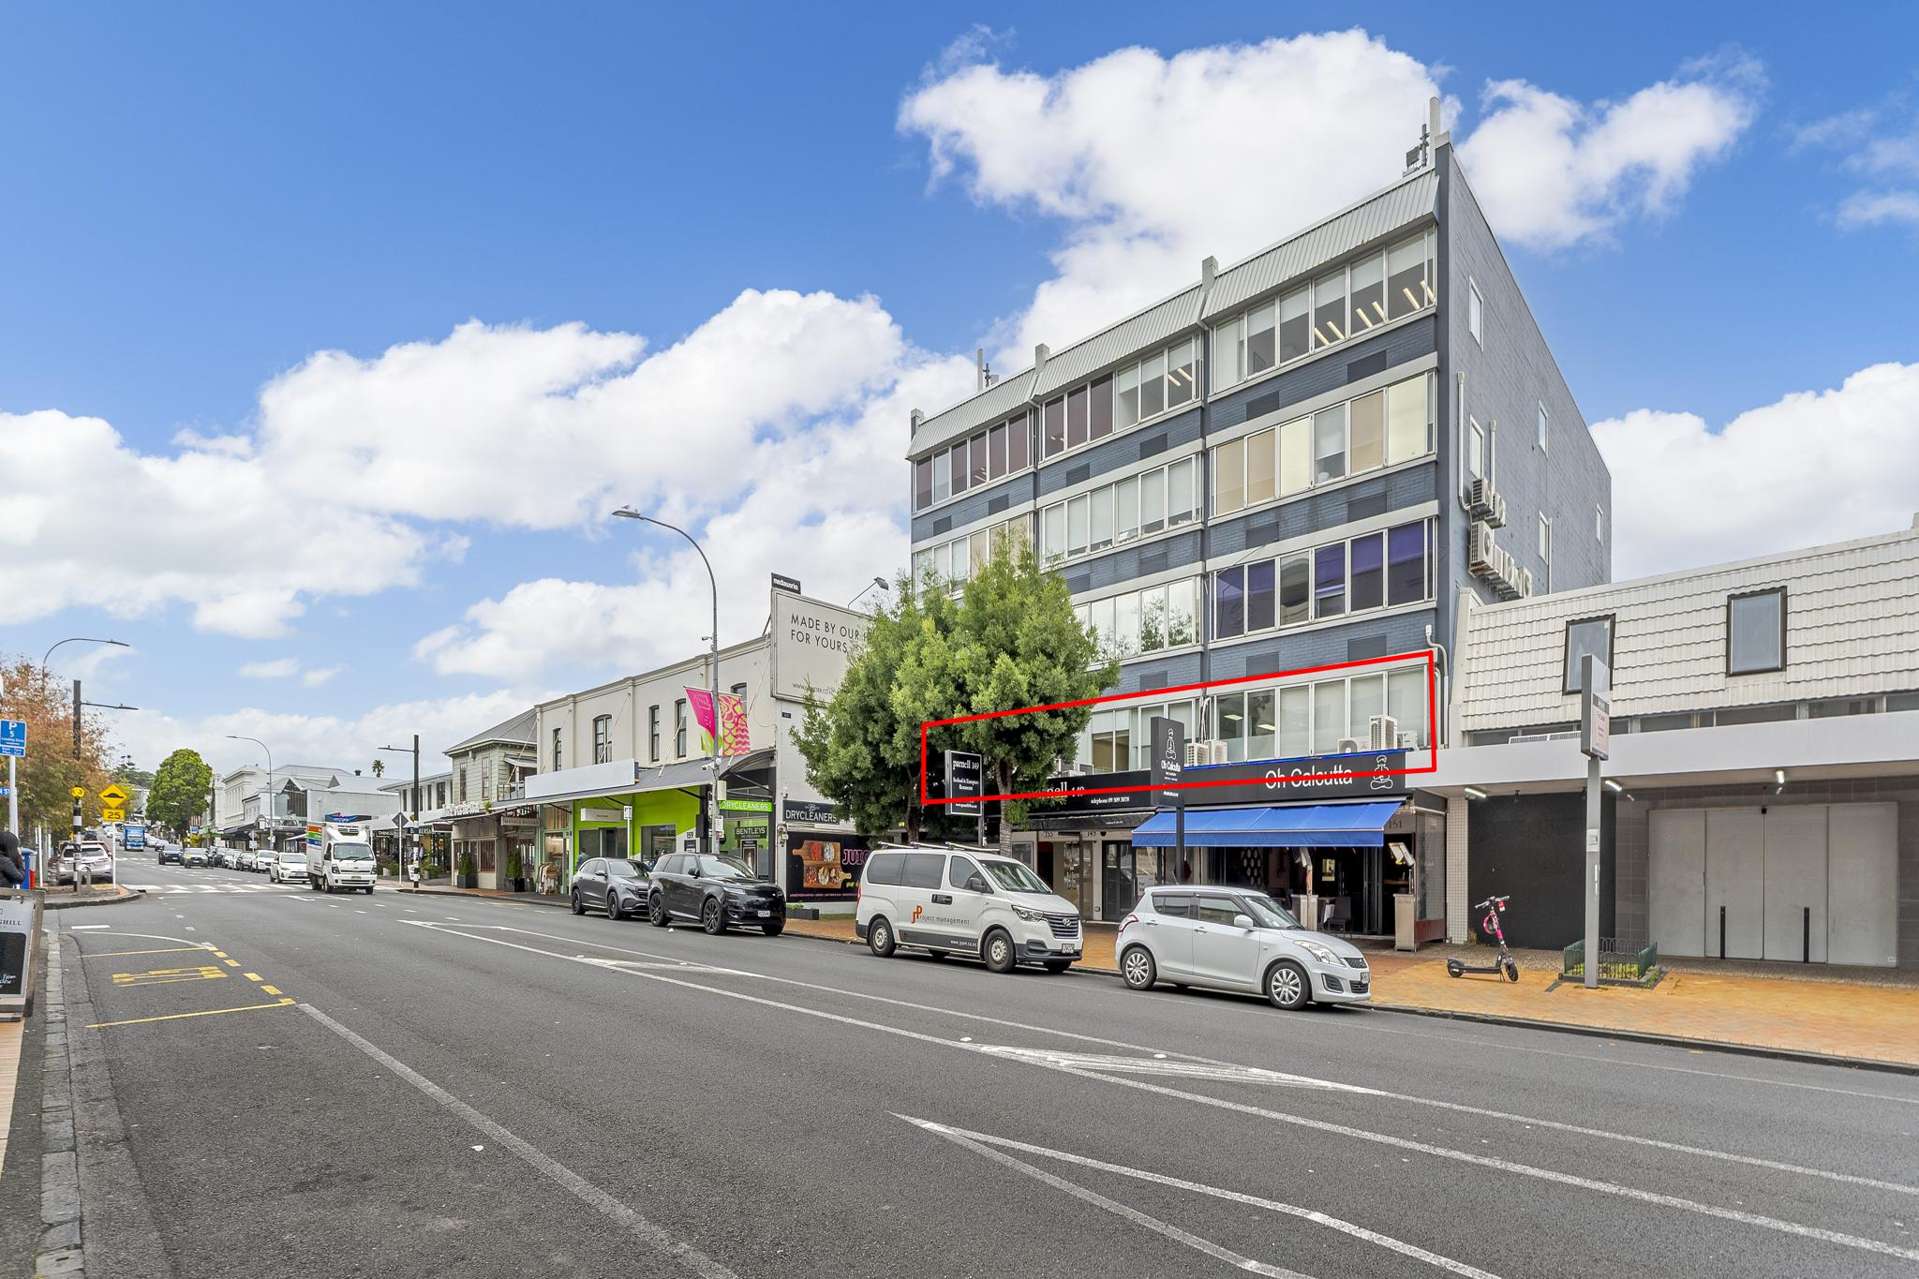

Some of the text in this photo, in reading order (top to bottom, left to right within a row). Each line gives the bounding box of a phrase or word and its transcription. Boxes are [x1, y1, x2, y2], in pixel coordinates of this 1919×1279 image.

[791, 614, 820, 631] MADE
[824, 622, 836, 635] BY
[840, 626, 859, 640] OUR
[791, 630, 811, 644] FOR
[8, 722, 17, 731] P
[1265, 765, 1353, 789] Oh Calcutta
[785, 809, 837, 823] DRYCLEANERS
